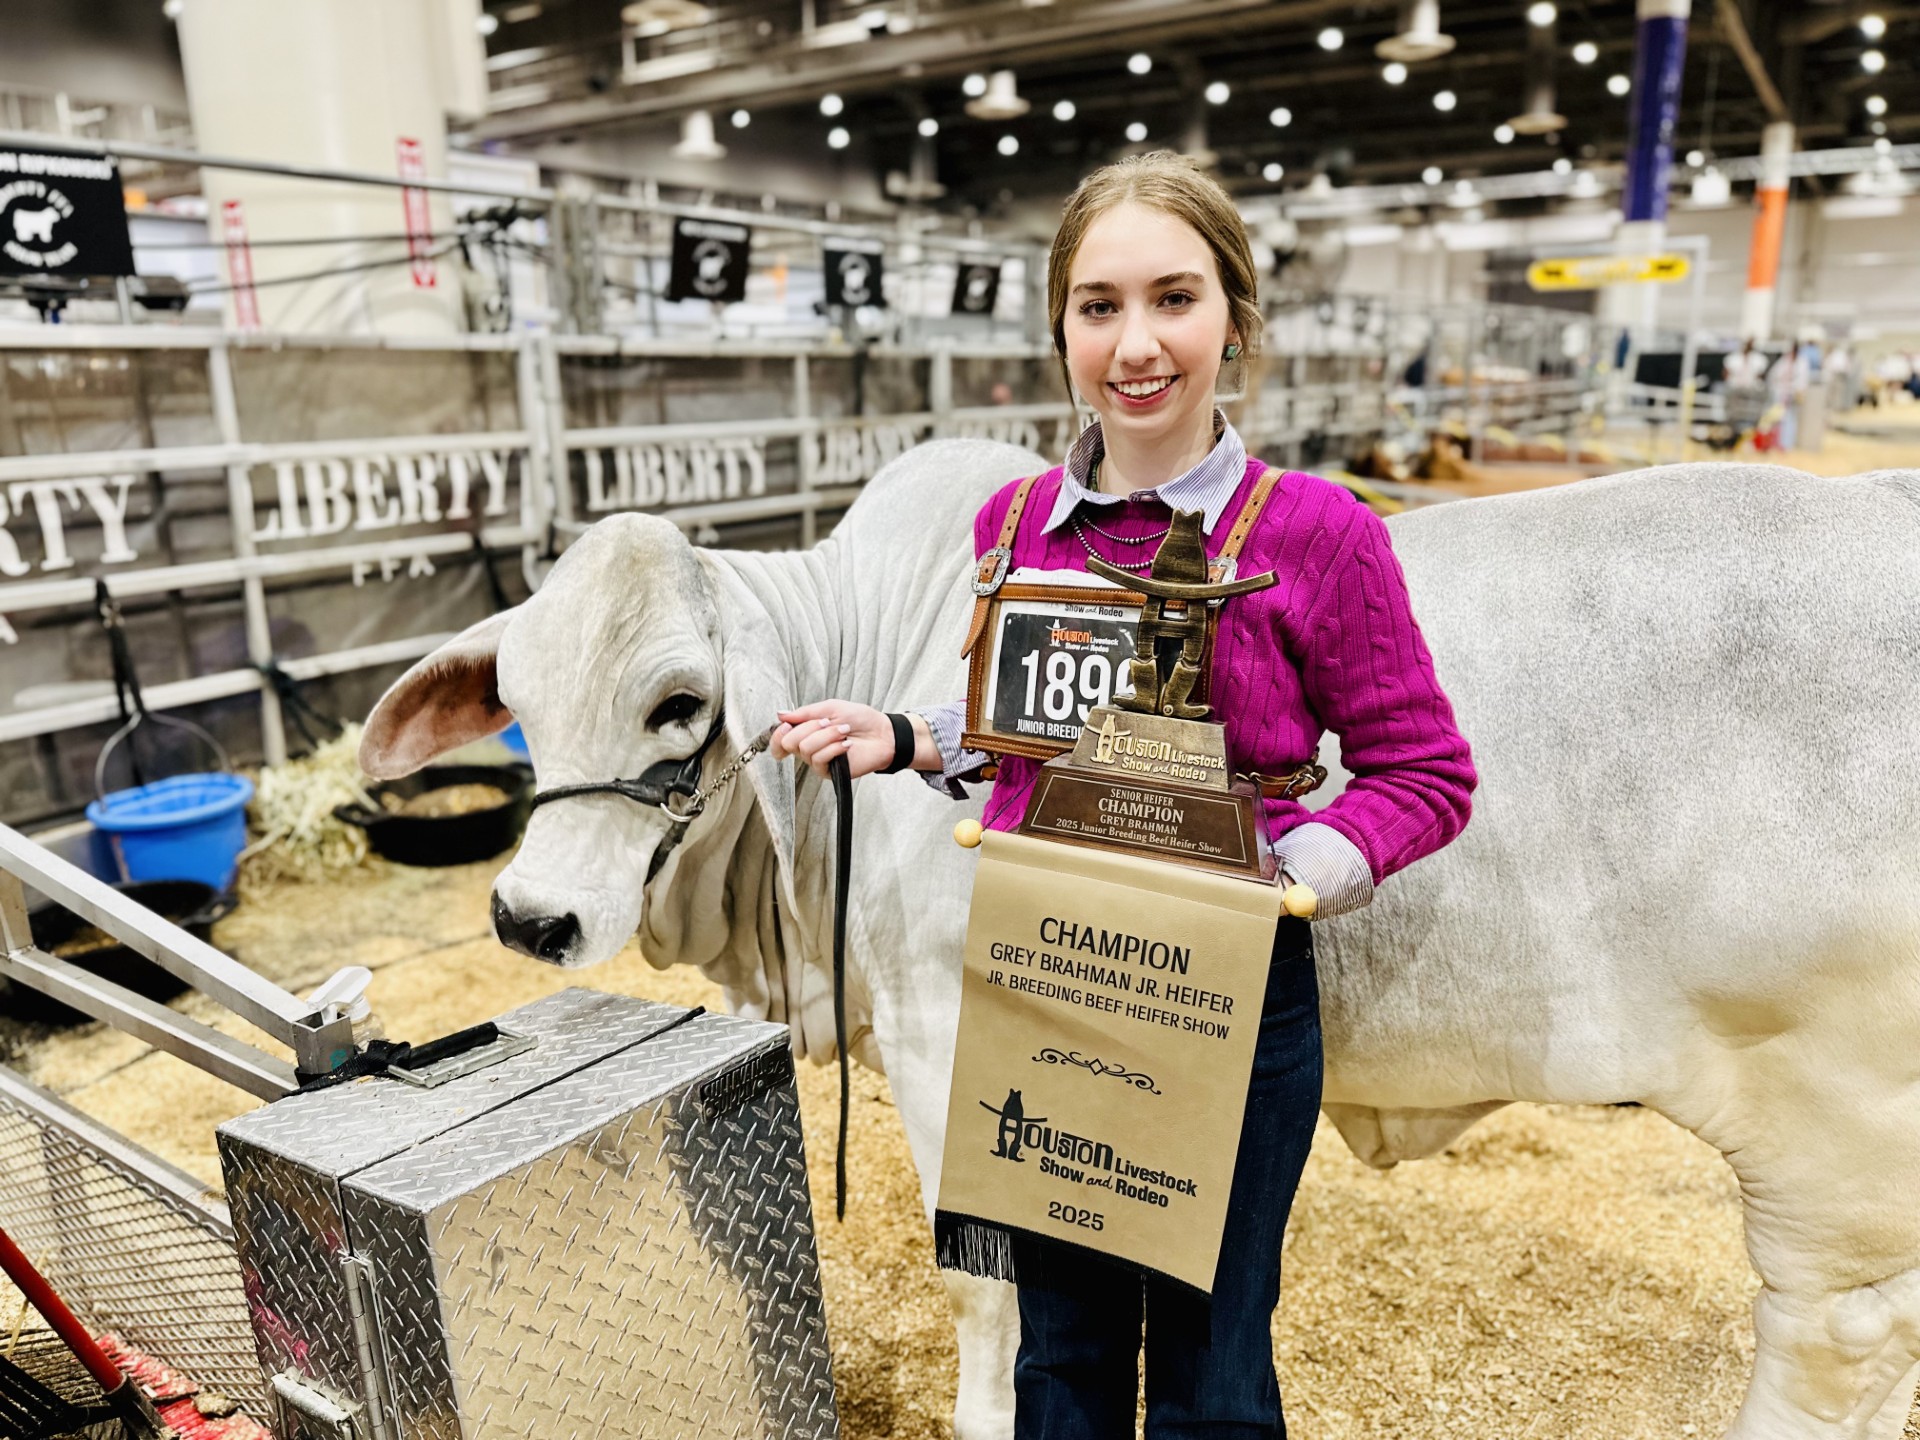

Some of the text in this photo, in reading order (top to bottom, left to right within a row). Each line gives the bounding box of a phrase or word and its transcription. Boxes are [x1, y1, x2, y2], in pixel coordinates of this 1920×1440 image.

[585, 437, 766, 511] LIBERTY
[247, 450, 508, 542] LIBERTY
[352, 553, 436, 587] FFA
[1098, 606, 1124, 617] Rodeo
[1065, 642, 1080, 650] Show
[1090, 644, 1110, 653] Rodeo
[1016, 718, 1084, 740] JUNIOR BREEDI
[1121, 756, 1207, 782] Show and Rodeo
[1172, 749, 1225, 770] Livestock
[1098, 797, 1184, 824] CHAMPION
[1110, 788, 1174, 807] SENIOR HEIFER
[1056, 817, 1223, 855] 2025 Junior Breeding Beef Heifer Show
[1100, 814, 1178, 836] GREY BRAHMAN
[1039, 917, 1191, 975] CHAMPION
[990, 942, 1234, 1015] GREY BRAHMAN JR. HEIFER
[987, 970, 1230, 1040] JR. BREEDING BEEF HEIFER SHOW
[1039, 1156, 1169, 1208] Show and Rodeo
[1115, 1157, 1198, 1197] Livestock
[1048, 1201, 1104, 1231] 2025
